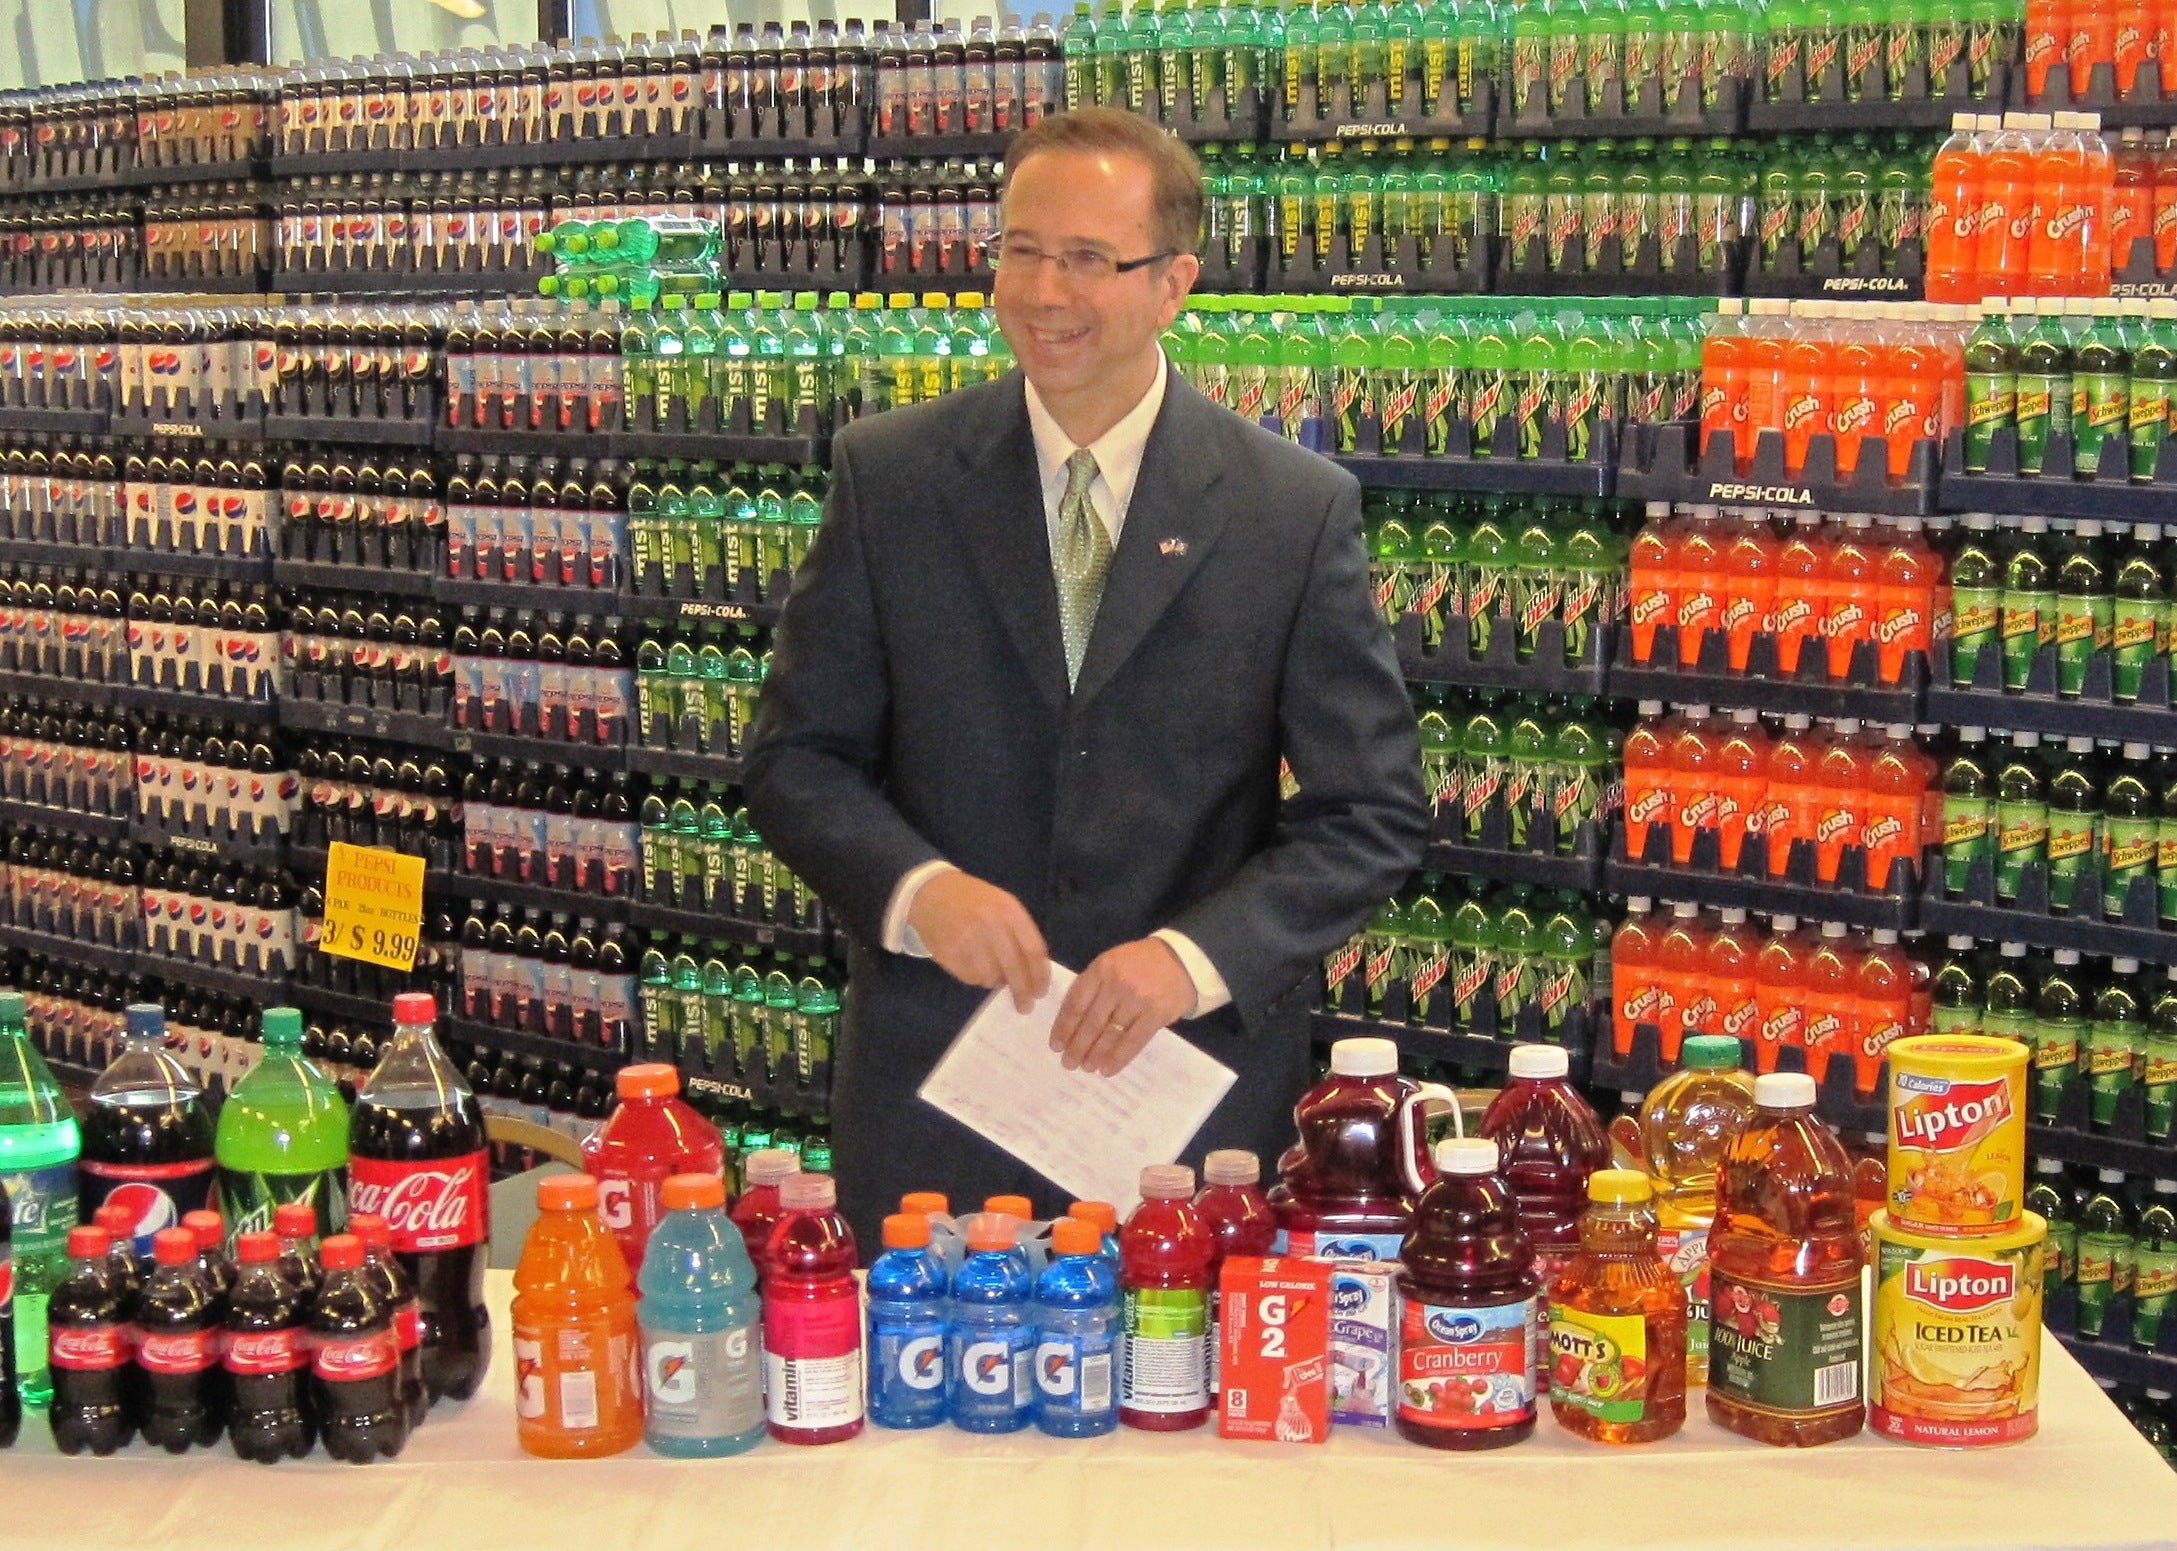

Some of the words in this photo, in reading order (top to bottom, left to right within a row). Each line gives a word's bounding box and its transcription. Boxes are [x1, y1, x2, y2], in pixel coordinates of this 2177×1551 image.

[1129, 54, 1143, 107] mist
[1162, 52, 1178, 107] mist
[1824, 278, 1909, 290] PEPSI-COLA
[2110, 282, 2177, 297] PSI-COLA
[656, 360, 671, 419] mist
[754, 360, 767, 421] mist
[1784, 394, 1820, 430] Crush
[1836, 396, 1876, 433] Crush
[1709, 482, 1813, 504] PEPSI-COLA
[725, 524, 739, 583] mist
[681, 603, 747, 618] PEPSI-COLA
[1632, 591, 1670, 625] Crush
[1677, 592, 1714, 627] Crush
[1776, 599, 1811, 633] Crush
[1827, 603, 1864, 637] Crush
[1880, 608, 1920, 643] Crush
[1629, 789, 1669, 823] Crush
[1681, 792, 1719, 827] Crush
[1816, 810, 1854, 843] Crush
[1865, 815, 1902, 849] Crush
[355, 852, 397, 875] PEPSI
[337, 870, 413, 899] PRODUCTS
[372, 928, 416, 961] 9.99
[1762, 1007, 1801, 1041] Crush
[1804, 1013, 1840, 1046] Crush
[1863, 1022, 1903, 1057] Crush
[1899, 1093, 2004, 1143] Lipton
[350, 1166, 474, 1232] ca-Cola
[599, 1180, 632, 1229] G
[1259, 1280, 1278, 1289] LOW
[1913, 1268, 2008, 1303] Lipton
[1258, 1294, 1287, 1325] G
[726, 1330, 748, 1357] G
[1259, 1327, 1287, 1357] 2
[1334, 1321, 1374, 1341] Grape
[1431, 1319, 1455, 1336] Ocean
[1455, 1323, 1479, 1339] Spray
[1915, 1321, 1965, 1344] ICED
[1966, 1324, 2003, 1344] TEA
[900, 1335, 944, 1389] G
[1412, 1346, 1504, 1374] Cranberry
[1737, 1334, 1774, 1361] JUICE
[648, 1342, 697, 1404] G
[963, 1342, 1009, 1396] G
[1035, 1342, 1075, 1396] G
[1231, 1391, 1243, 1407] 8
[1914, 1424, 1960, 1436] NATURAL
[1963, 1426, 1999, 1436] LEMON
